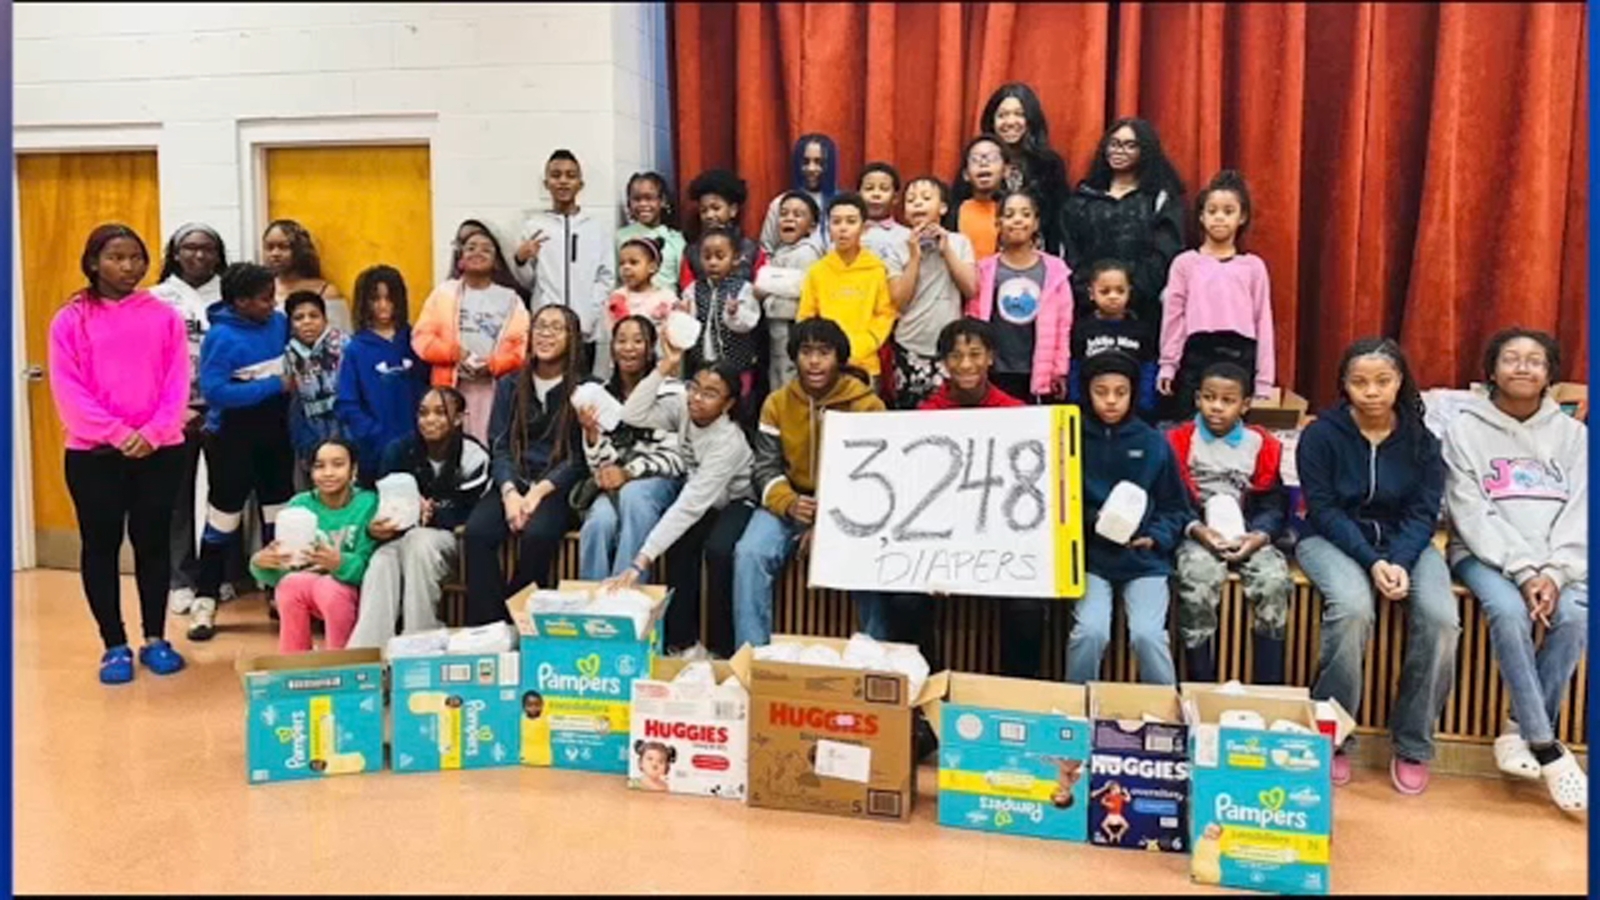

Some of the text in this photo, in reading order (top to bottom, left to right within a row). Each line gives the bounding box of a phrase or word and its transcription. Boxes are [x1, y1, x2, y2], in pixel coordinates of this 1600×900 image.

[829, 435, 1047, 548] 3,248
[875, 549, 1038, 585] DIAPERS
[537, 661, 620, 696] Pampers
[285, 710, 307, 769] Pampers
[465, 699, 486, 757] Pampers
[645, 719, 729, 743] HUGGIES
[1091, 754, 1189, 781] HUGGIES
[979, 796, 1044, 823] Pampers
[1215, 793, 1307, 829] Pampers
[1172, 837, 1182, 850] 6
